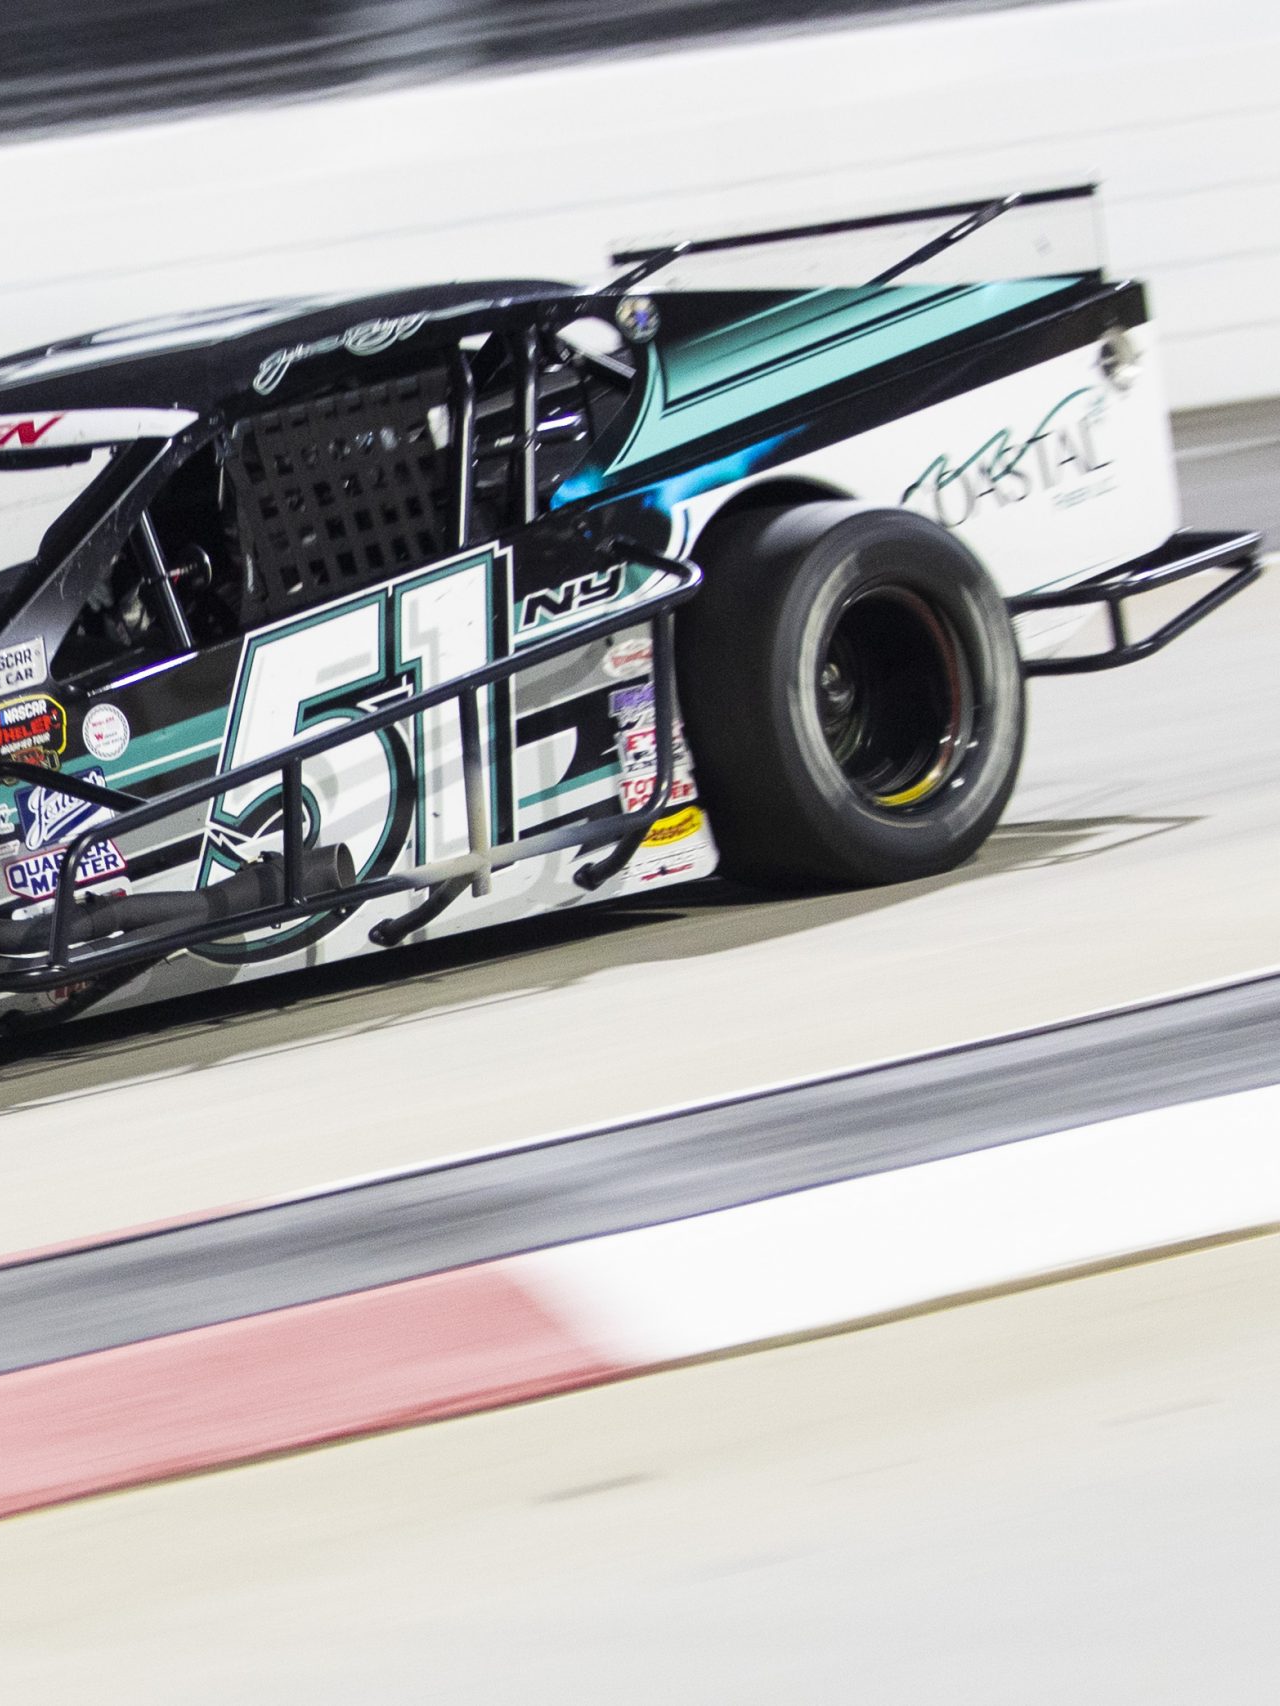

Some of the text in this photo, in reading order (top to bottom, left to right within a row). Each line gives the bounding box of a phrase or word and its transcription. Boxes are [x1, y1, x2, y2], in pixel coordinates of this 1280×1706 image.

[520, 561, 627, 632] NY
[6, 668, 34, 686] CAR
[4, 700, 48, 725] NASCAR
[195, 543, 514, 963] 51
[627, 783, 694, 811] POER
[9, 839, 111, 888] QUARER
[31, 854, 120, 895] MATER
